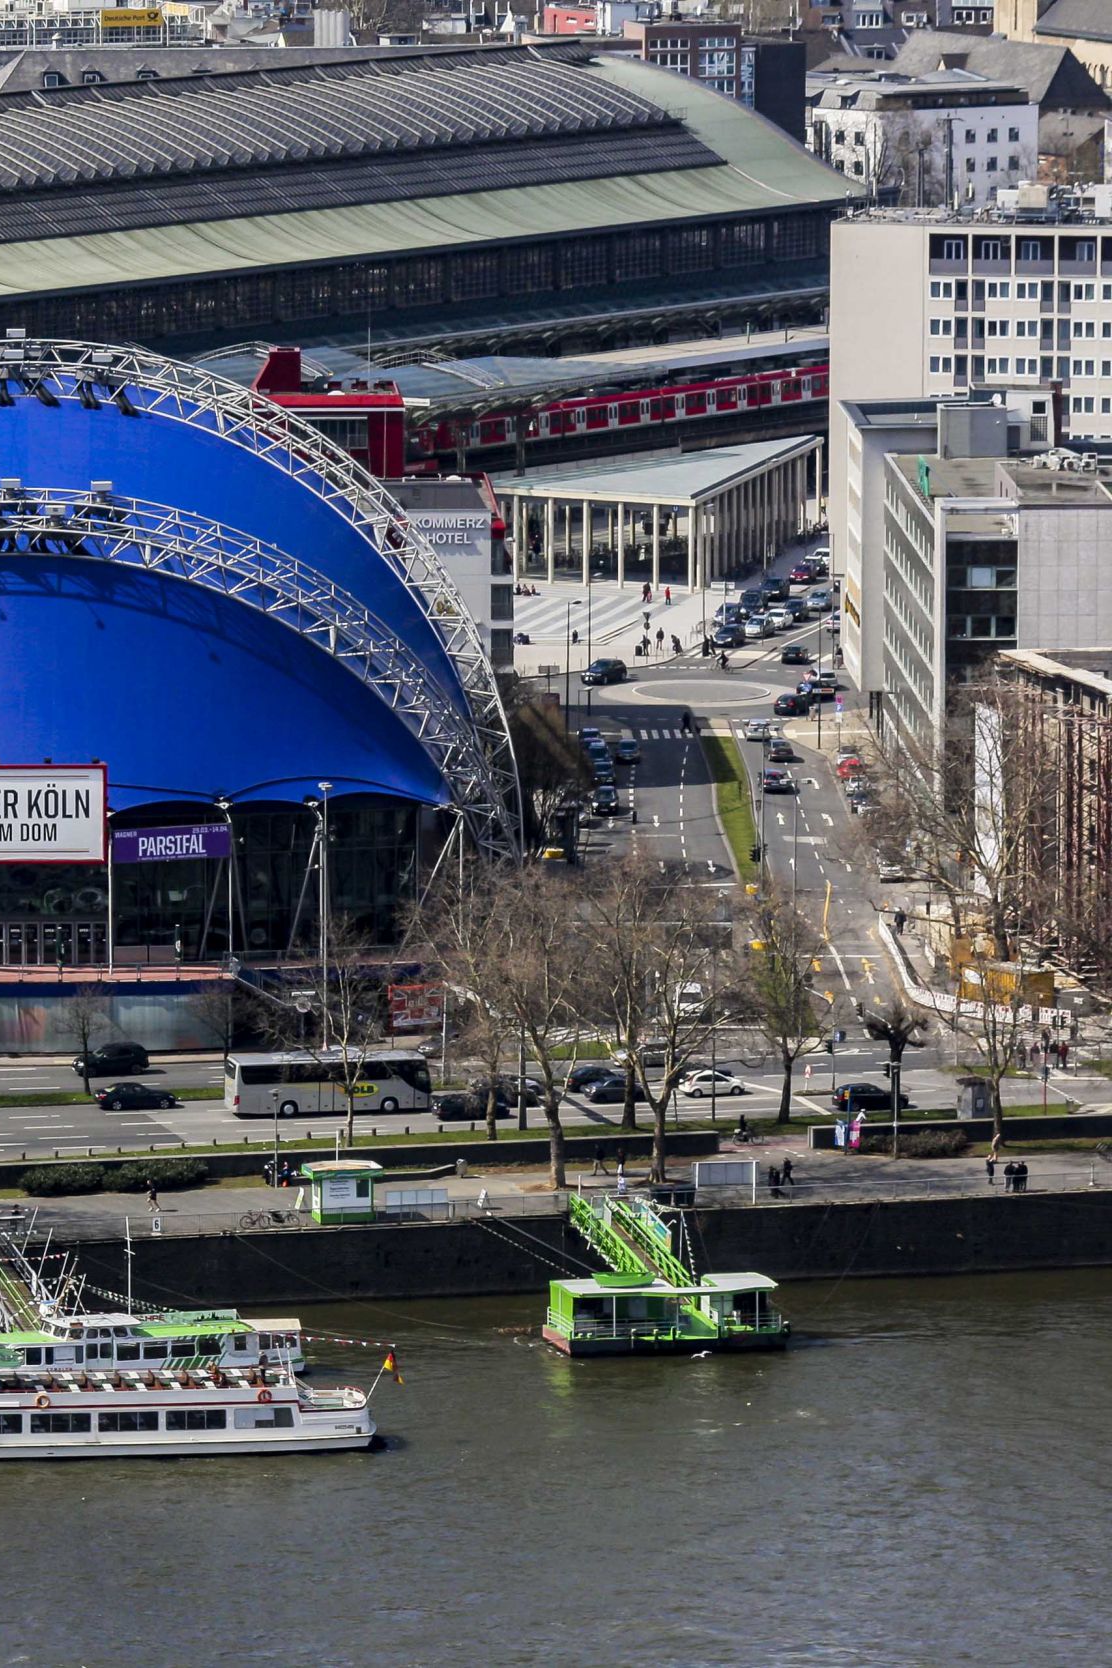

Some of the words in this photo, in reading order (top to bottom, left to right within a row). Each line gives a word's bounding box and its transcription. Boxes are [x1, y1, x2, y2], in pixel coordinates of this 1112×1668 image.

[426, 532, 472, 544] HOTEL
[27, 783, 90, 819] KÖLN
[20, 823, 57, 842] DOM
[138, 834, 207, 856] PARSIFAL
[345, 1084, 374, 1094] OLB
[154, 1219, 160, 1230] 6
